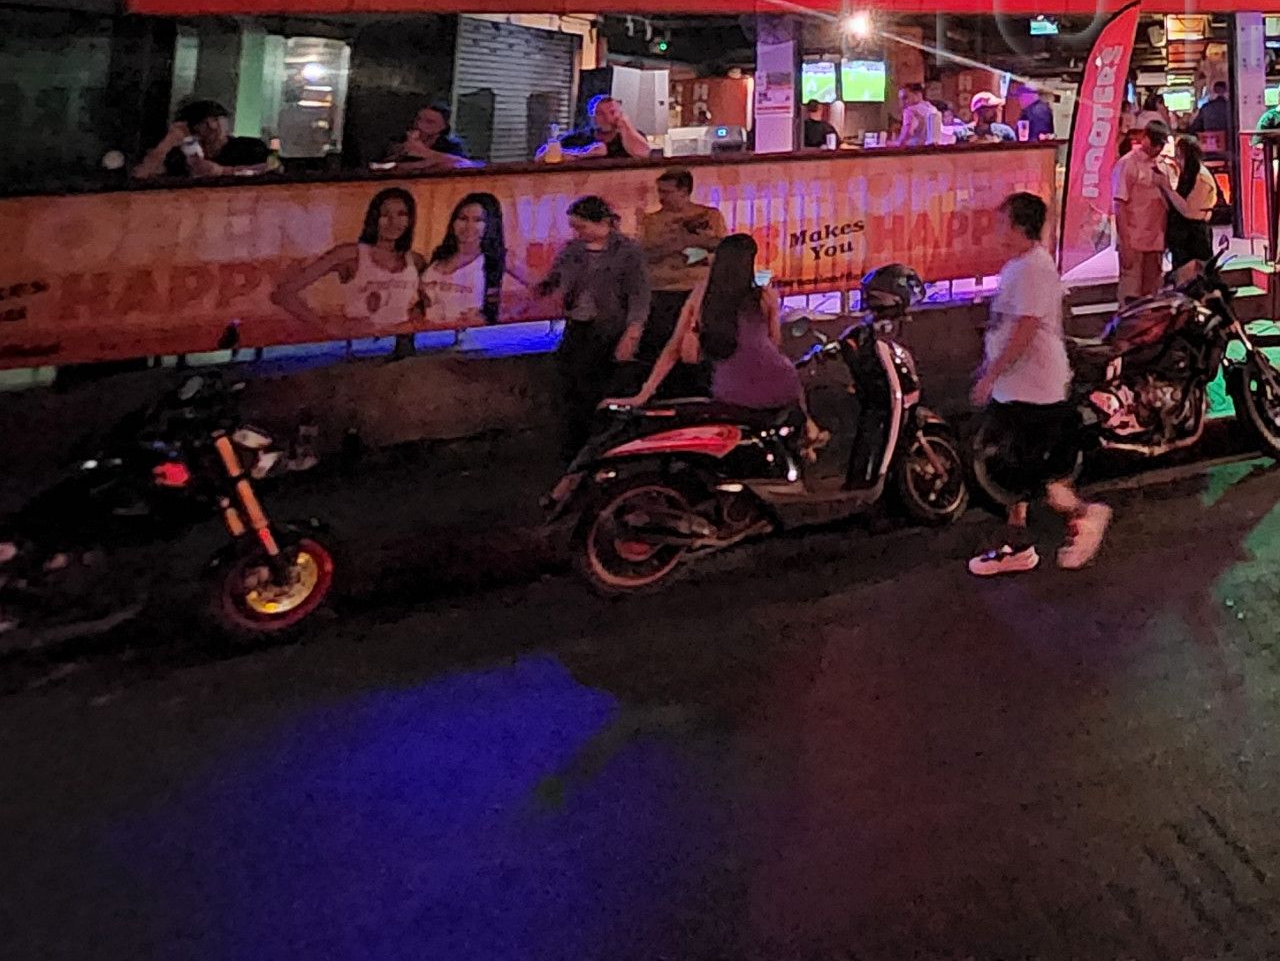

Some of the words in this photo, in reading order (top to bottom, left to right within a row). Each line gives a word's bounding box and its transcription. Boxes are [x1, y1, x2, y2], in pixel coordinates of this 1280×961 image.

[1081, 45, 1124, 198] HOOTERS
[789, 219, 865, 248] Makes
[810, 241, 853, 261] You
[869, 208, 1000, 256] HAPP
